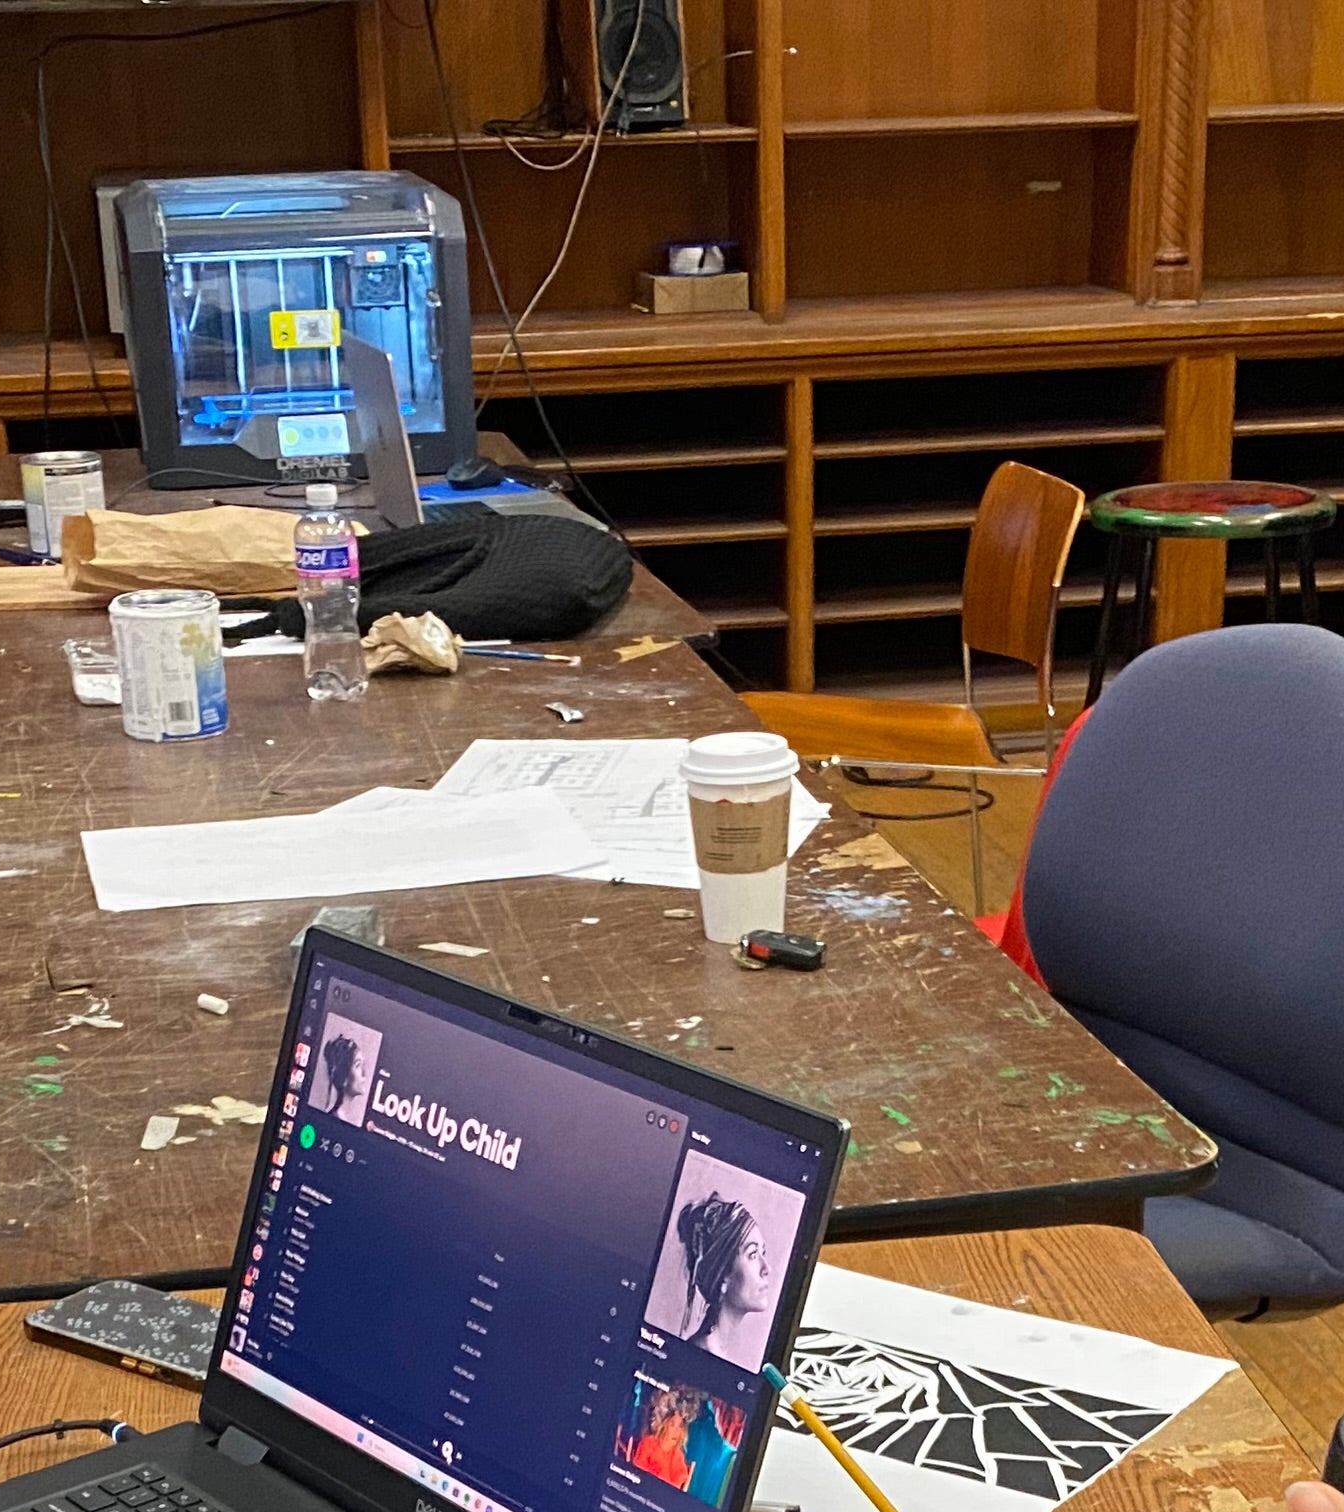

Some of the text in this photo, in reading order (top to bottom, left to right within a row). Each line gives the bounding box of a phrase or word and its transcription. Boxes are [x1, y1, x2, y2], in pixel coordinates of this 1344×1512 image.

[276, 456, 352, 470] DREMEL
[282, 467, 349, 480] DIGILAB
[371, 1079, 423, 1130] Look
[426, 1102, 457, 1147] Up
[459, 1117, 523, 1171] Child
